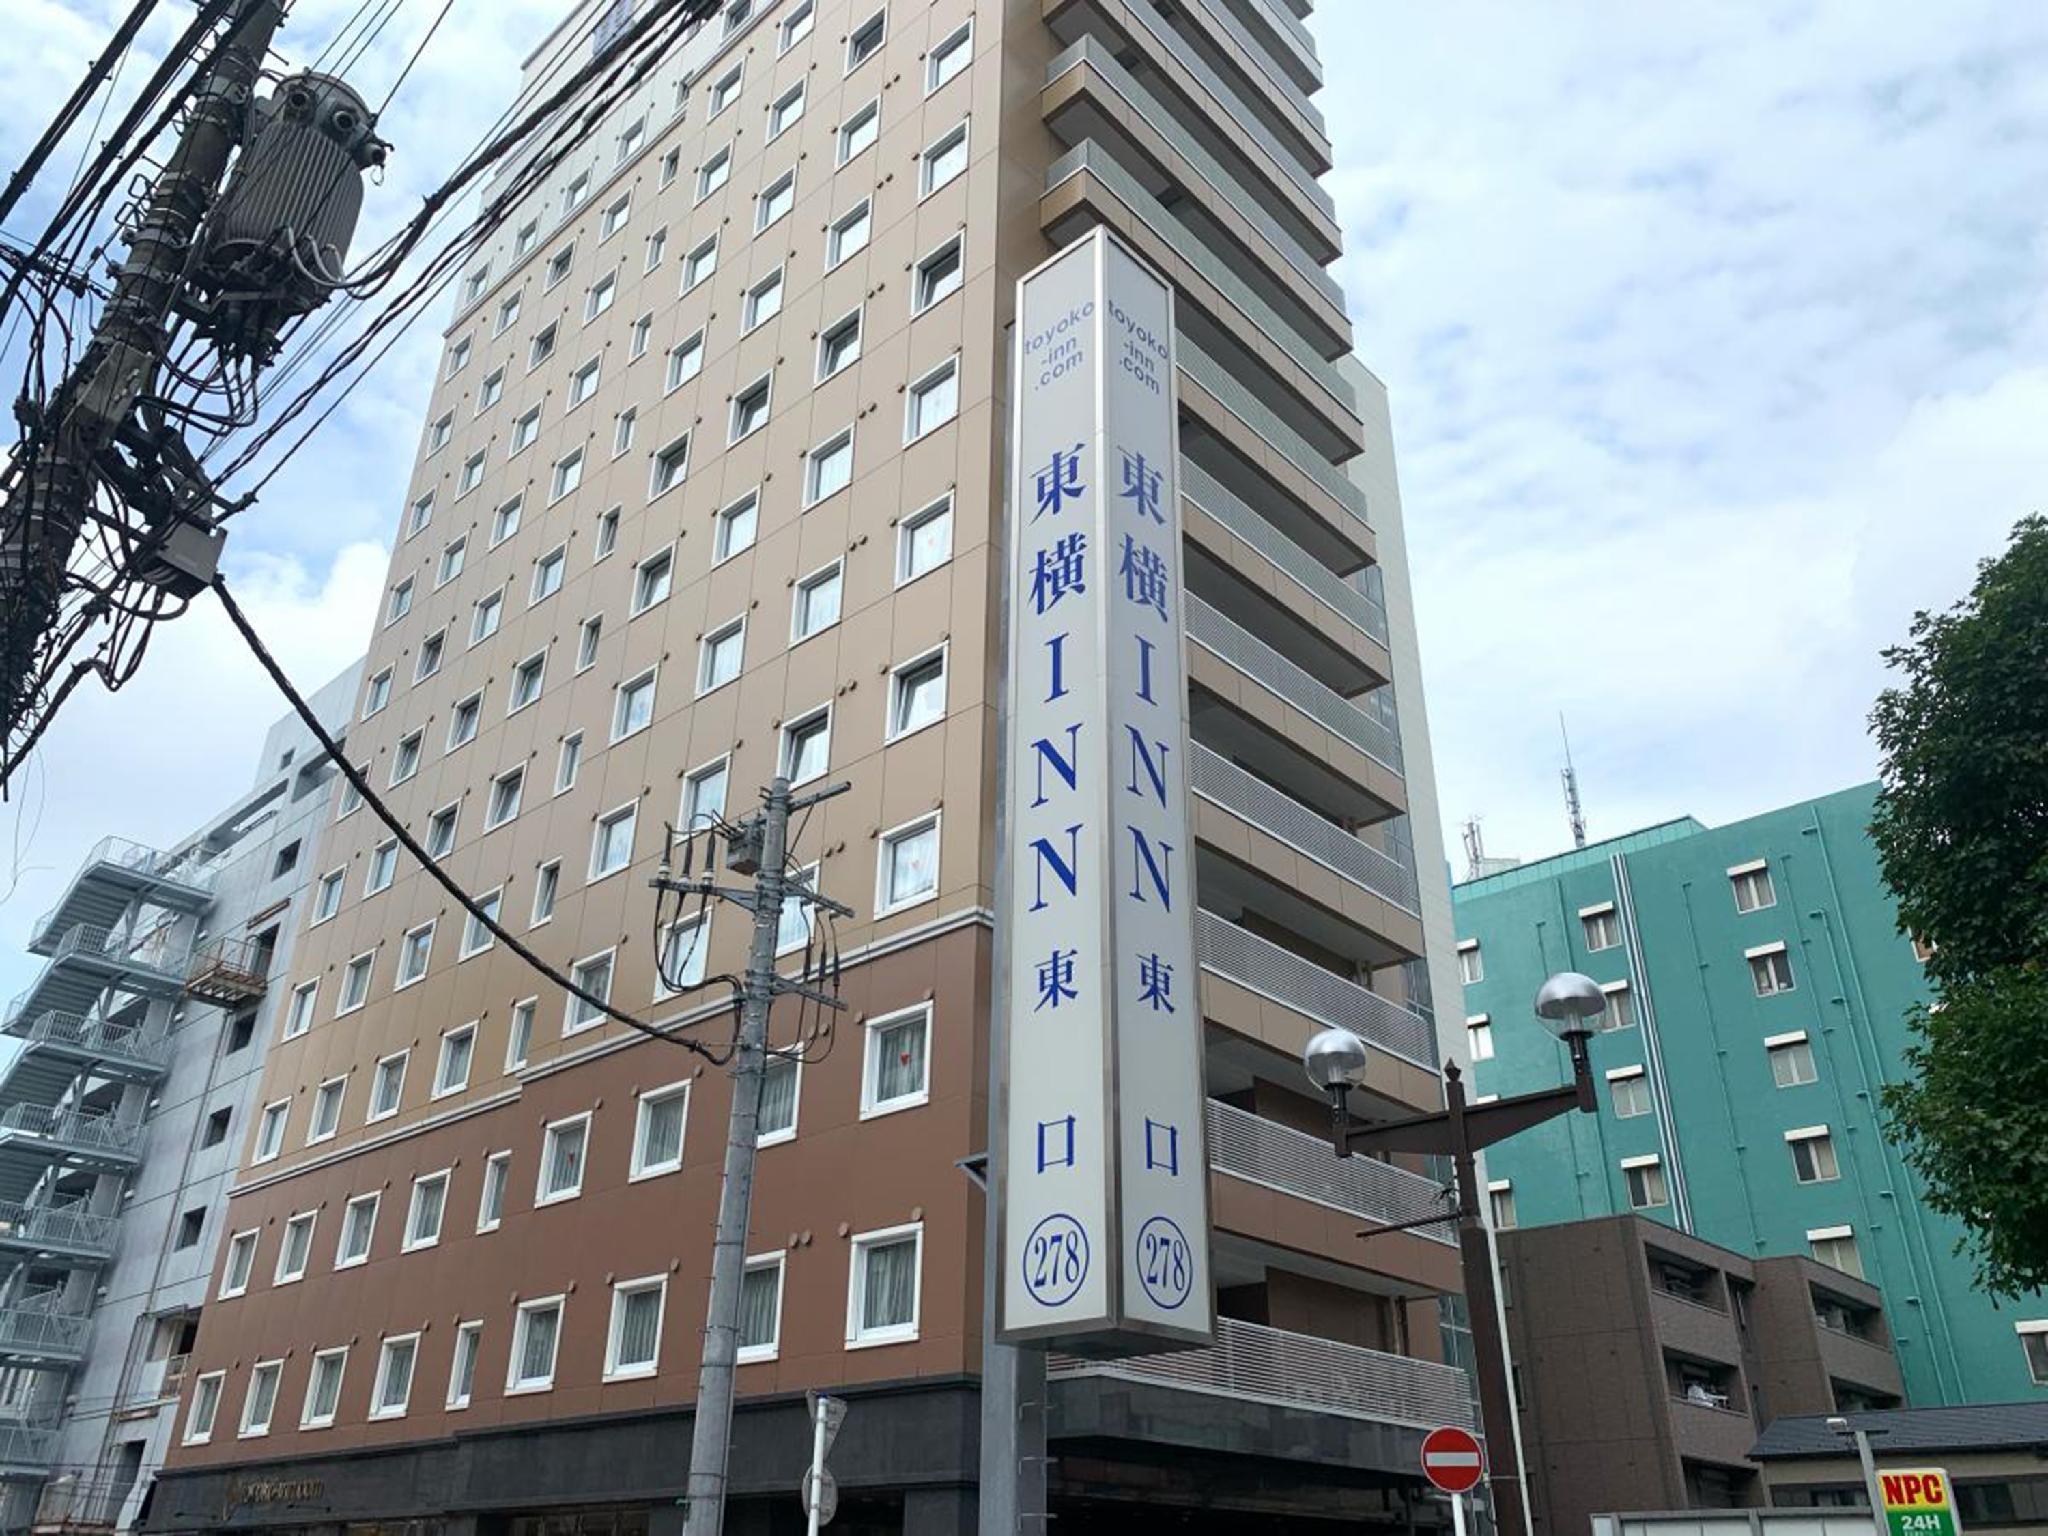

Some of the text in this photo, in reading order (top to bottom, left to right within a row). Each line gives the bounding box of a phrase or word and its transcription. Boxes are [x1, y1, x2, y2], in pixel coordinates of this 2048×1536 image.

[1024, 301, 1095, 354] toyoko
[1108, 300, 1168, 360] toyoko
[1041, 337, 1077, 366] -inn
[1124, 341, 1154, 372] -inn
[1034, 351, 1083, 391] .com
[1119, 357, 1160, 394] .com
[1033, 1230, 1080, 1289] 278
[1145, 1232, 1186, 1291] 278
[1882, 1474, 1943, 1504] NPC
[1901, 1515, 1941, 1530] 24H
